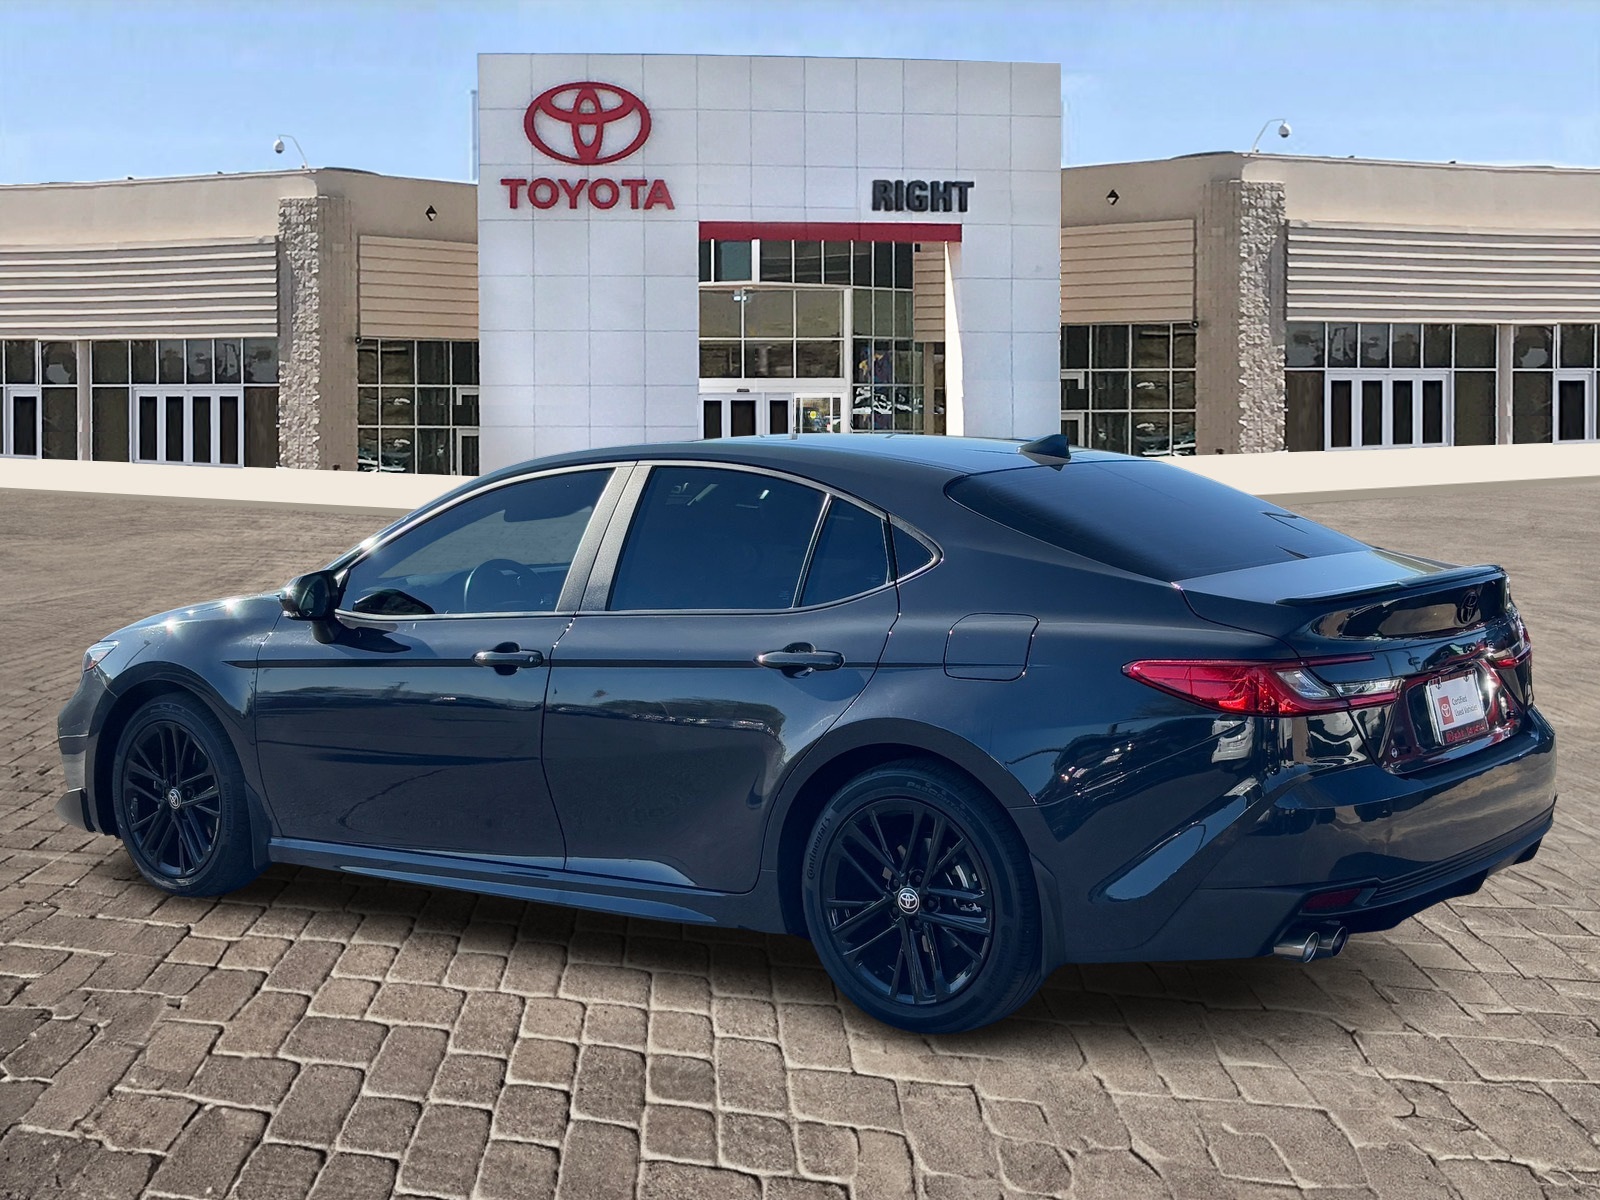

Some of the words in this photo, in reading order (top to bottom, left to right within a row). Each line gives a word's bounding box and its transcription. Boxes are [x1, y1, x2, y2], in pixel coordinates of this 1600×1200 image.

[500, 178, 675, 210] TOYOTA
[872, 179, 975, 212] RIGHT
[806, 822, 828, 880] Continental
